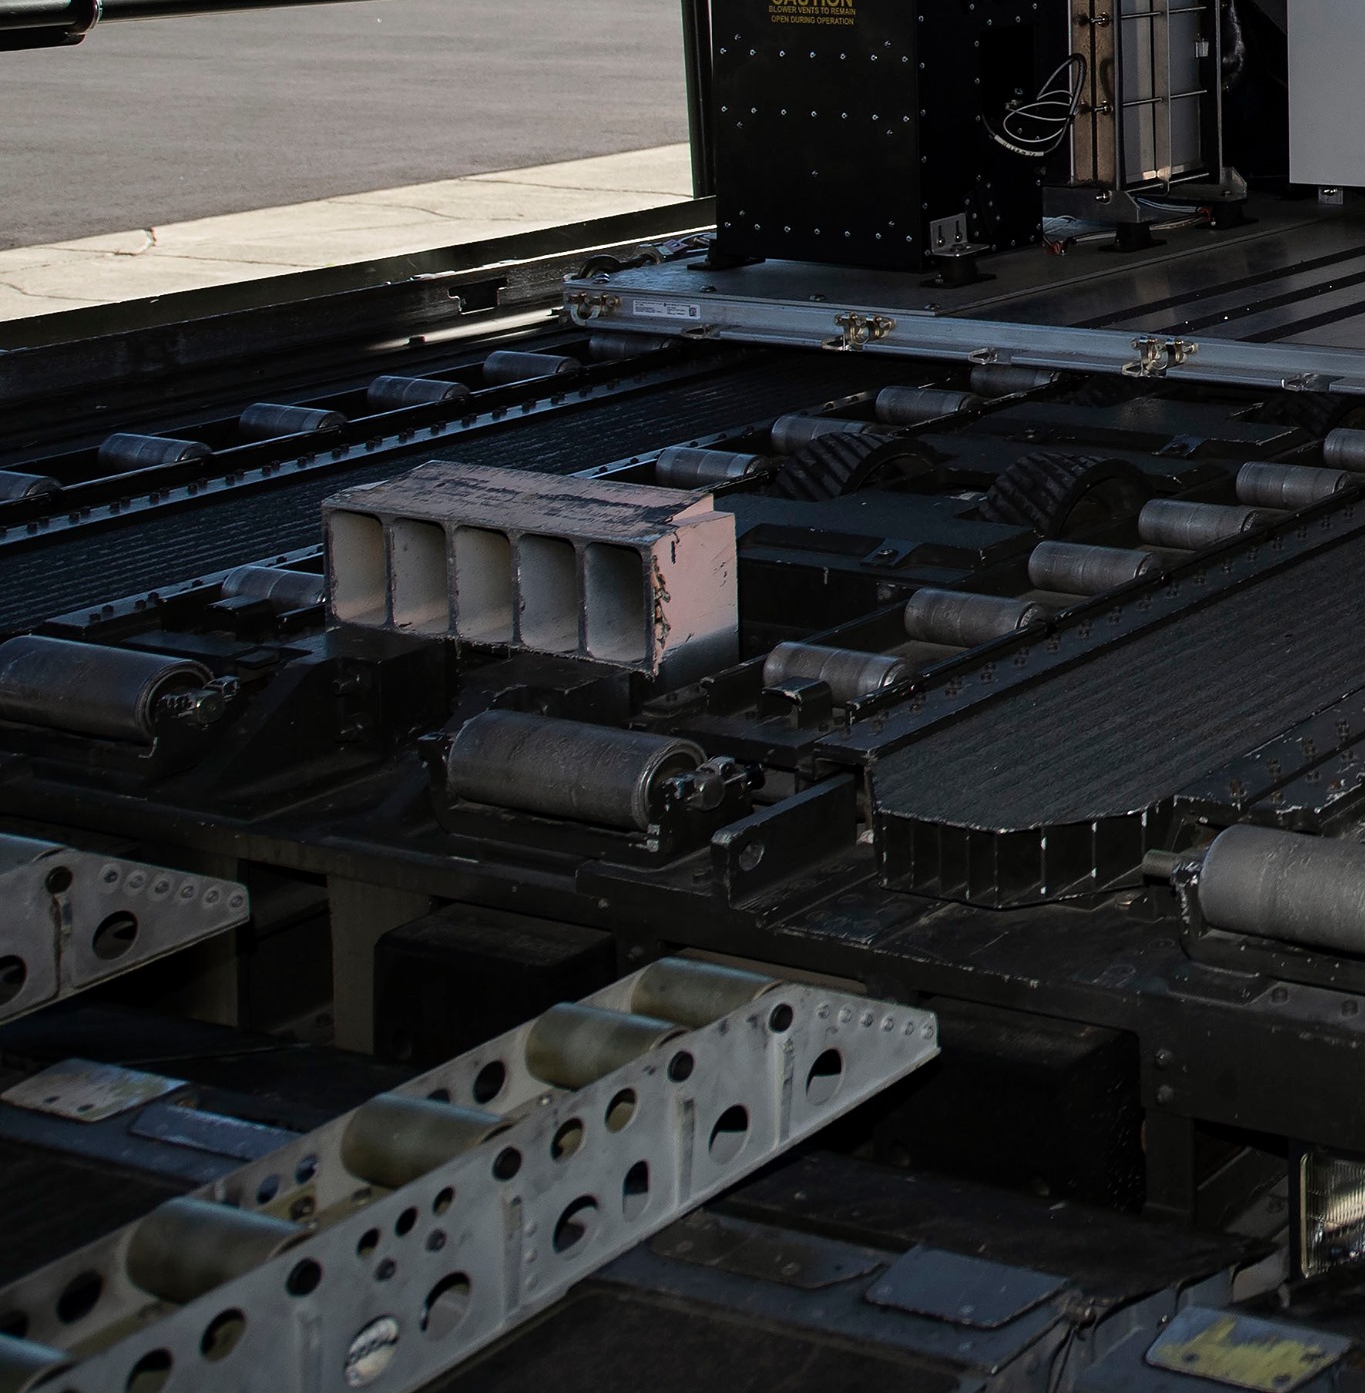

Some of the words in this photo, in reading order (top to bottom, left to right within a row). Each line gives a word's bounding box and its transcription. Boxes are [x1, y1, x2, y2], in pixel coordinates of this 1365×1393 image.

[768, 5, 797, 14] BLOWER
[799, 6, 819, 15] VENTS
[820, 7, 830, 15] TO
[830, 7, 856, 16] REMAIN
[771, 15, 789, 23] OPEN
[790, 15, 815, 24] DURING
[816, 17, 854, 25] OPERATION
